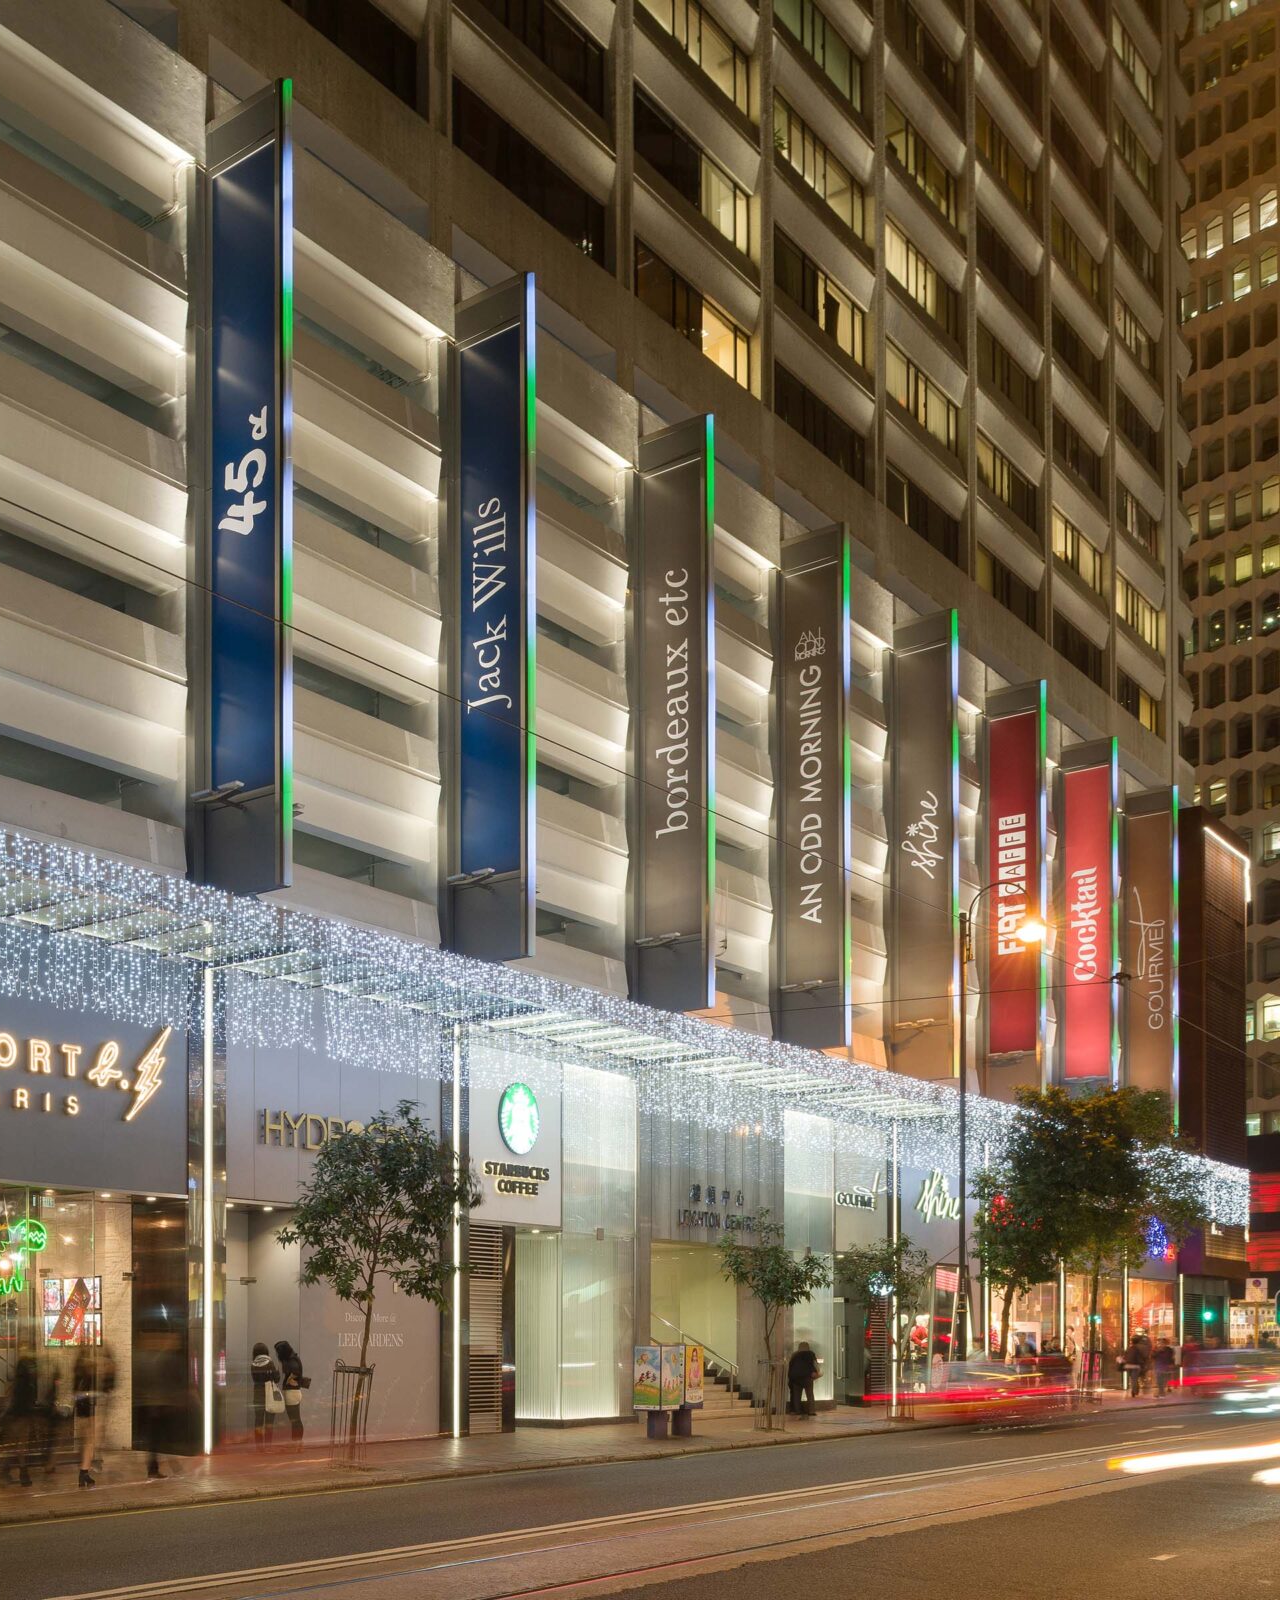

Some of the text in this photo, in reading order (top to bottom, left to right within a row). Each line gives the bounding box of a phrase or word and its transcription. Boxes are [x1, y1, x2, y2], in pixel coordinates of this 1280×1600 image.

[467, 497, 512, 714] Jack Wills
[655, 567, 689, 839] bordeaux etc
[799, 664, 823, 924] AN ODD MORNING
[998, 903, 1026, 956] FIAT
[1071, 866, 1098, 982] Cocktail
[264, 1109, 407, 1150] HYDRO
[484, 1160, 550, 1181] STARBUCKS
[497, 1179, 539, 1196] COFFEE
[344, 1312, 365, 1322] Disco
